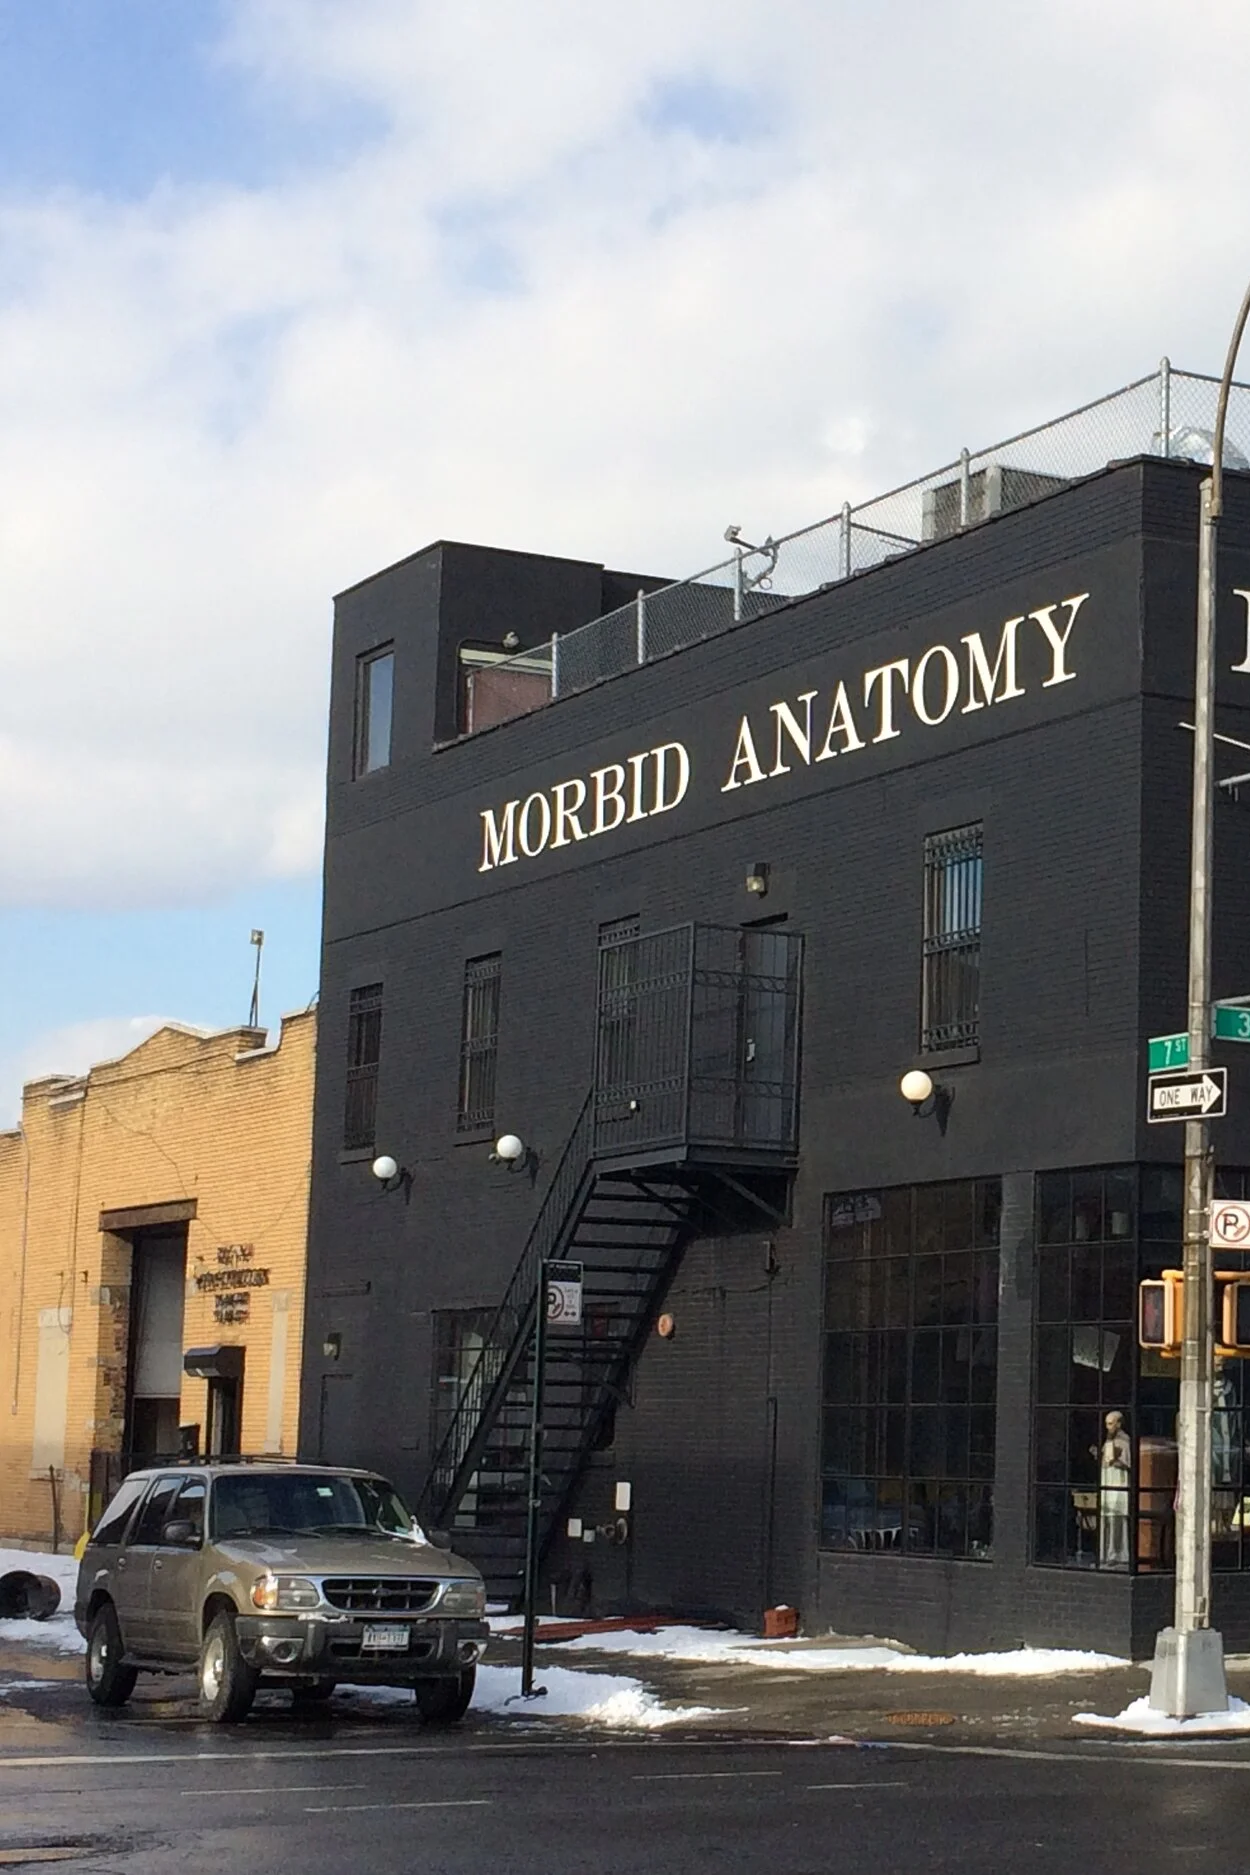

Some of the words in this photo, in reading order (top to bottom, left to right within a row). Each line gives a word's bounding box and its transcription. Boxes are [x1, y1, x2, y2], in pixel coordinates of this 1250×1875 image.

[478, 741, 691, 872] MORBID
[721, 593, 1090, 792] ANATOMY
[1164, 1041, 1173, 1065] 7
[1175, 1038, 1187, 1052] ST
[1160, 1088, 1181, 1106] ONE
[1190, 1085, 1213, 1103] WAY
